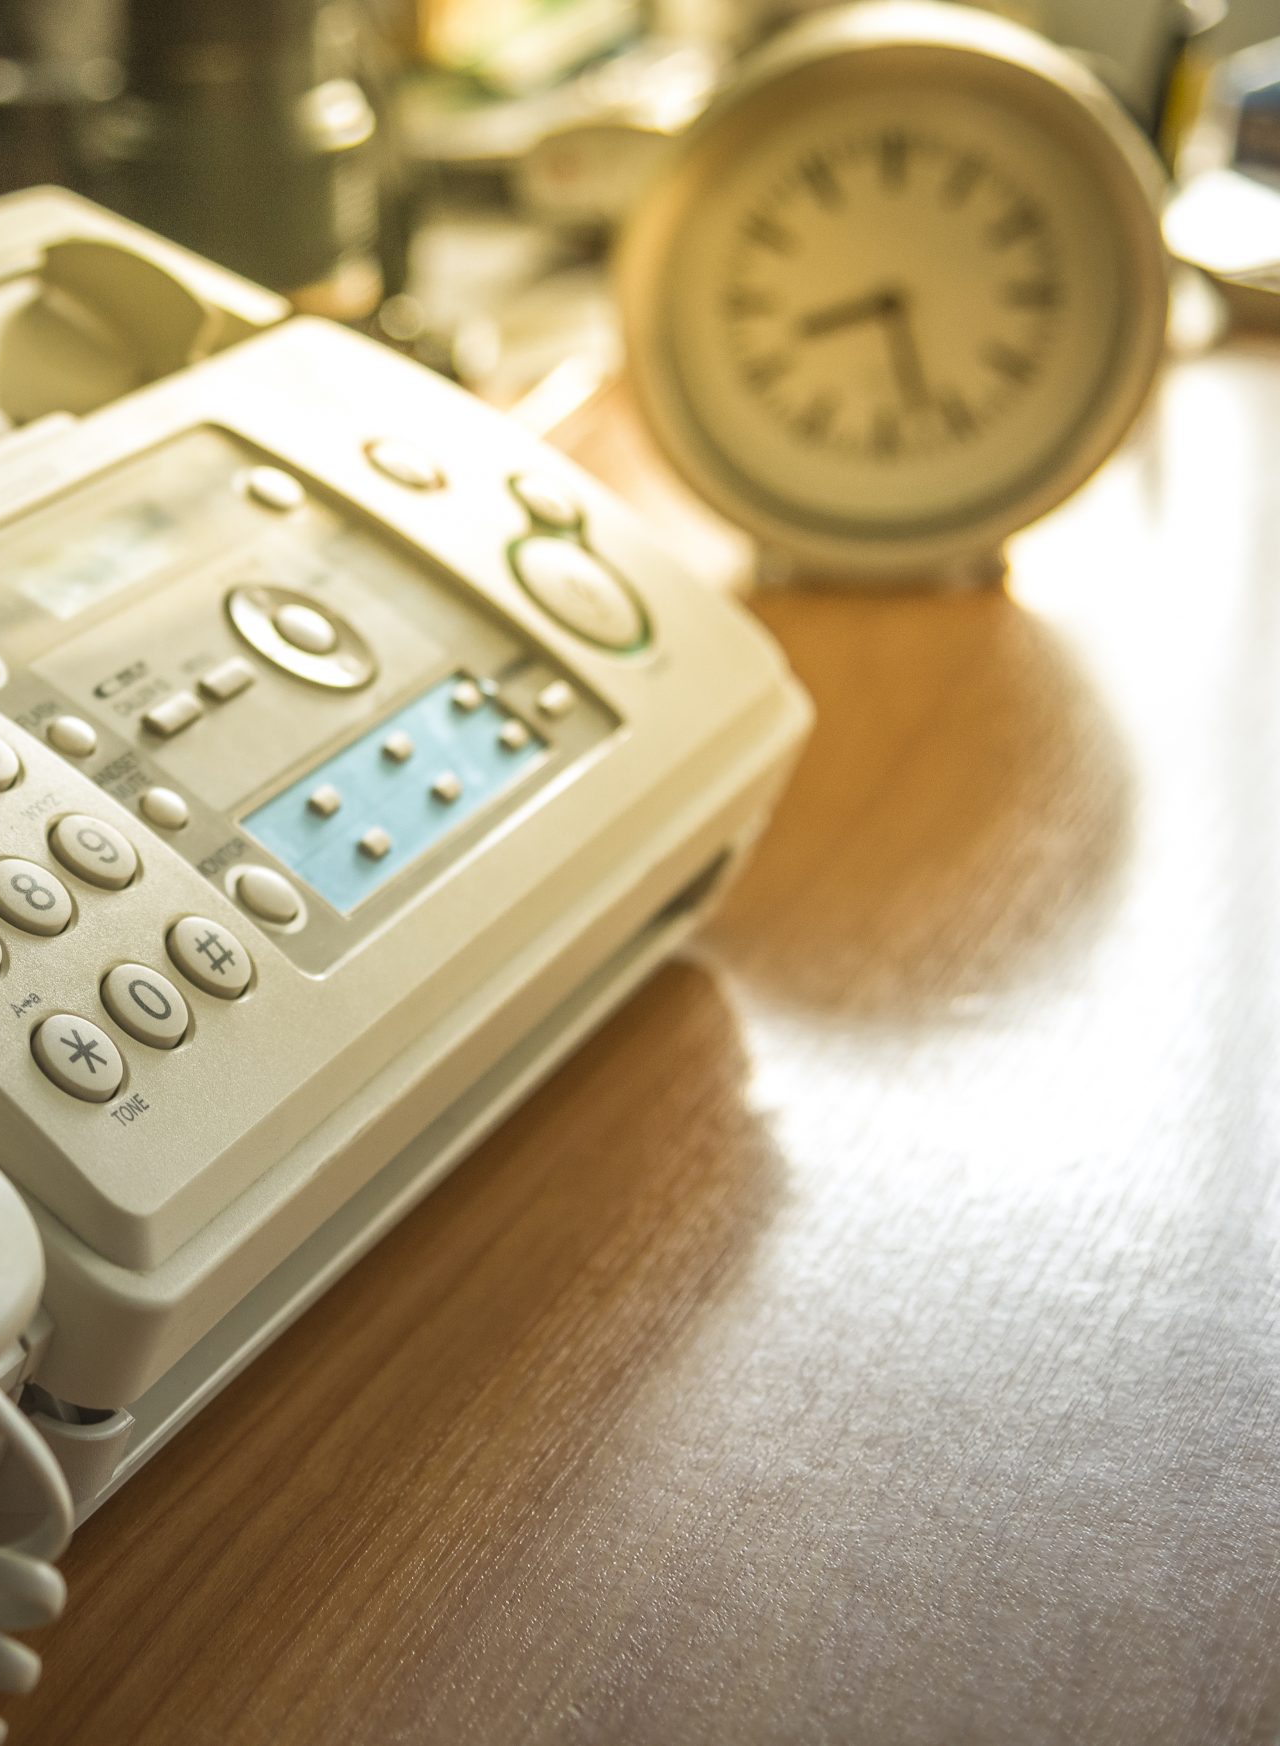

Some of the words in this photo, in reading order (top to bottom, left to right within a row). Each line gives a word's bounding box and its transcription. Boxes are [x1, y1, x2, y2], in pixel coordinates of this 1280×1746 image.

[76, 828, 120, 865] 9
[10, 872, 56, 912] 8
[195, 930, 234, 975] #
[110, 1092, 150, 1127] TONE
